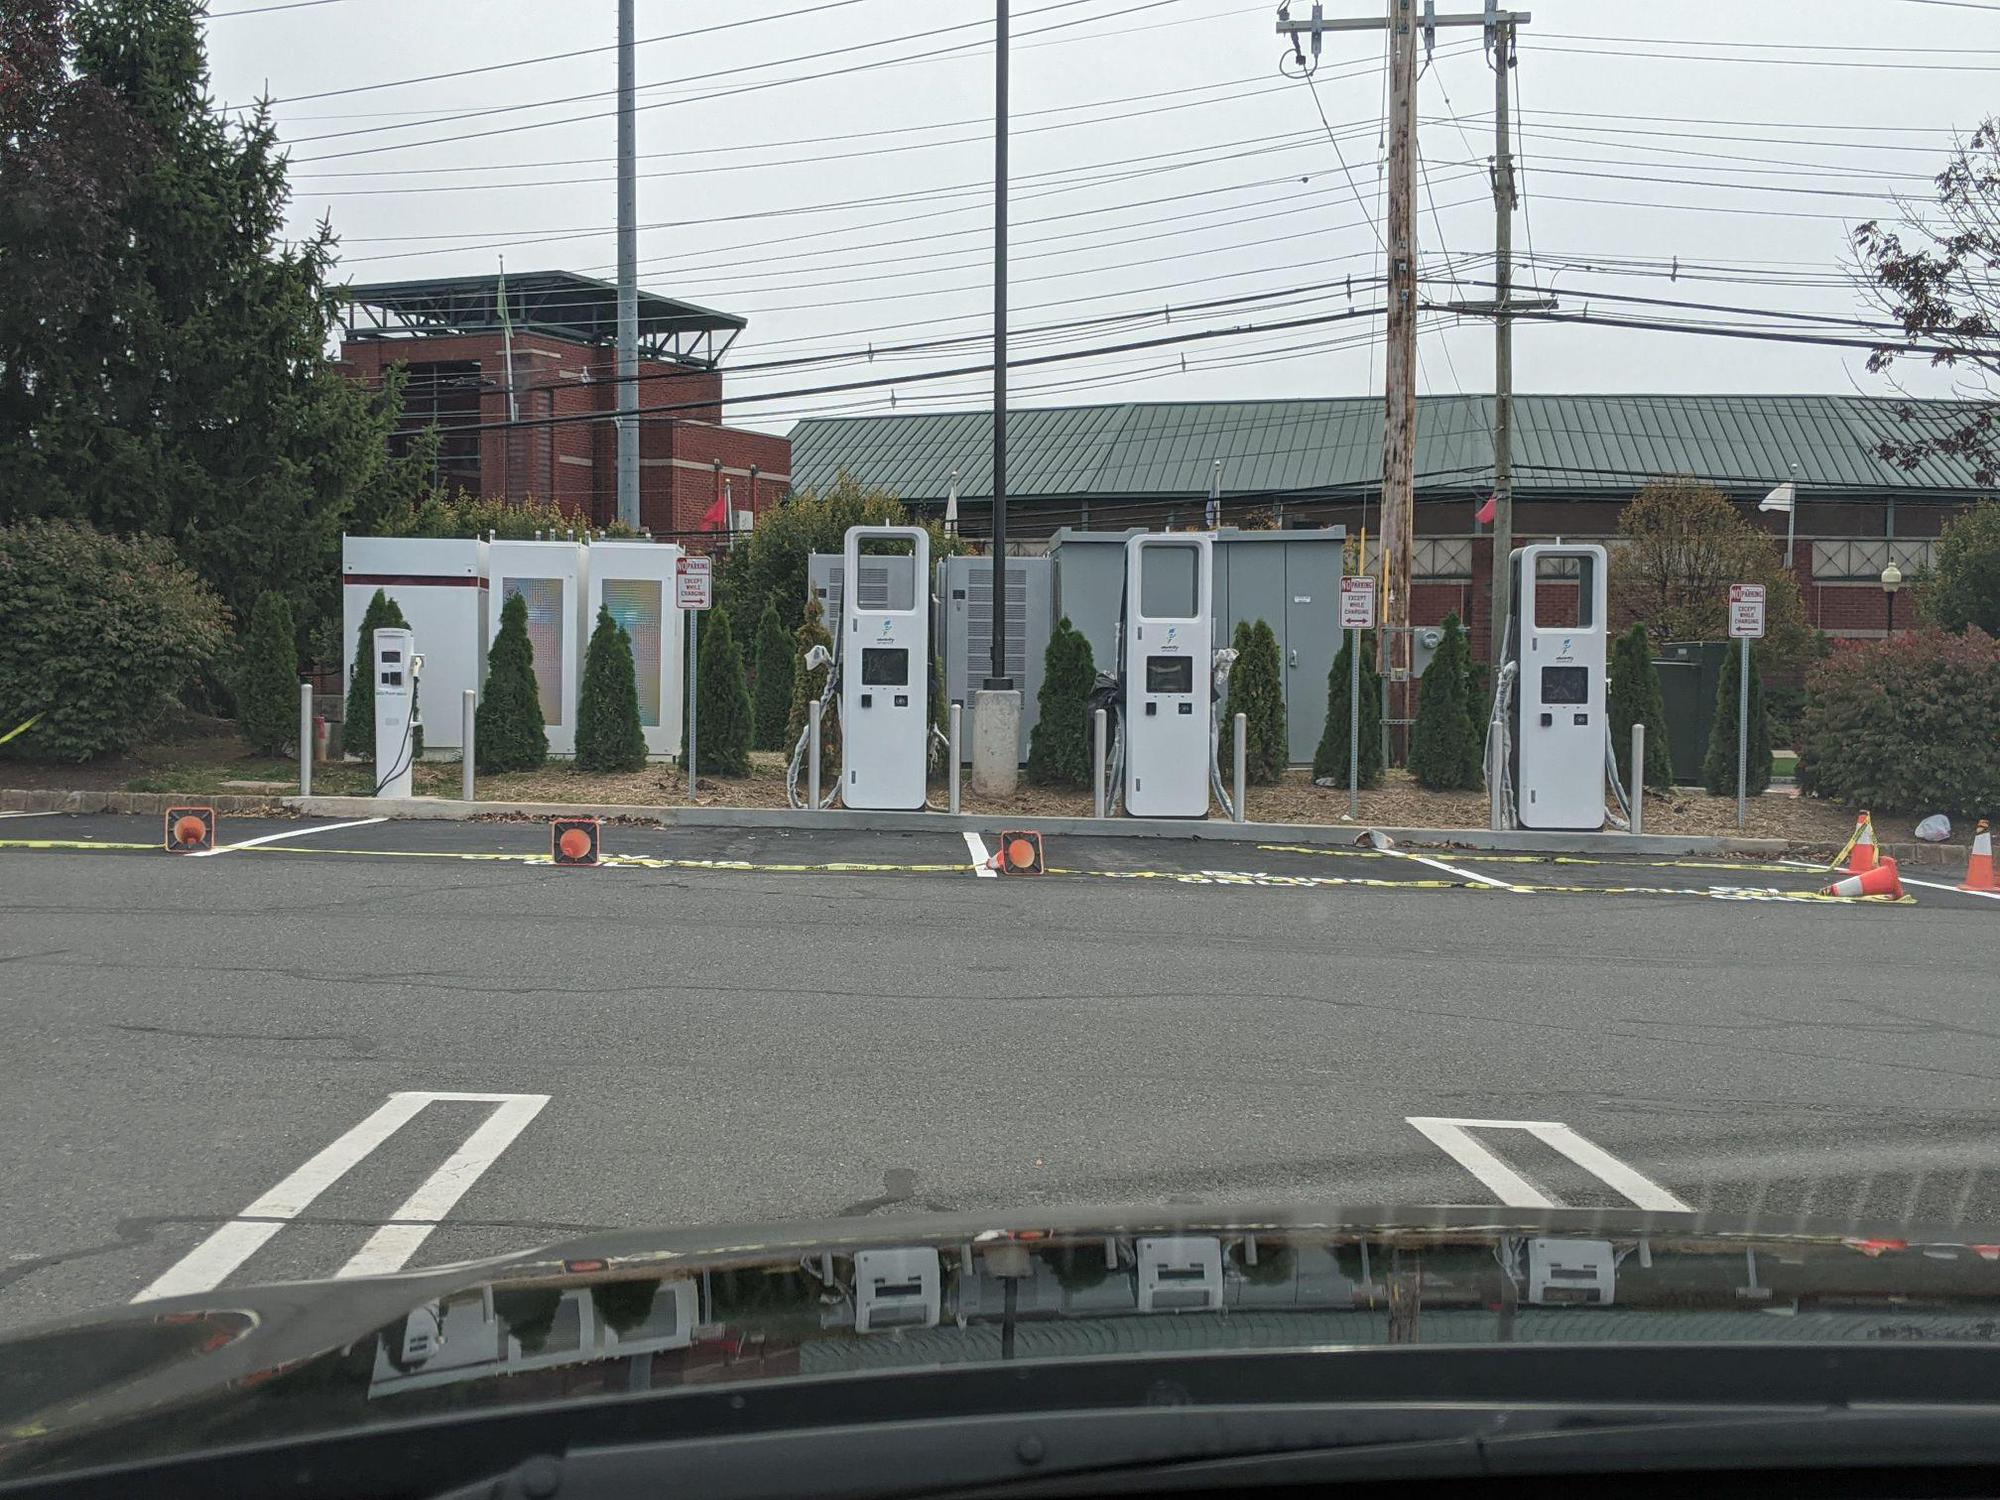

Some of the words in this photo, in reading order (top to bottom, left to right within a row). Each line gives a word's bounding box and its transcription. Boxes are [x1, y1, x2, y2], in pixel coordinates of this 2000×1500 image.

[677, 560, 687, 571] NO
[1342, 580, 1351, 590] NO
[1731, 589, 1741, 600] NO
